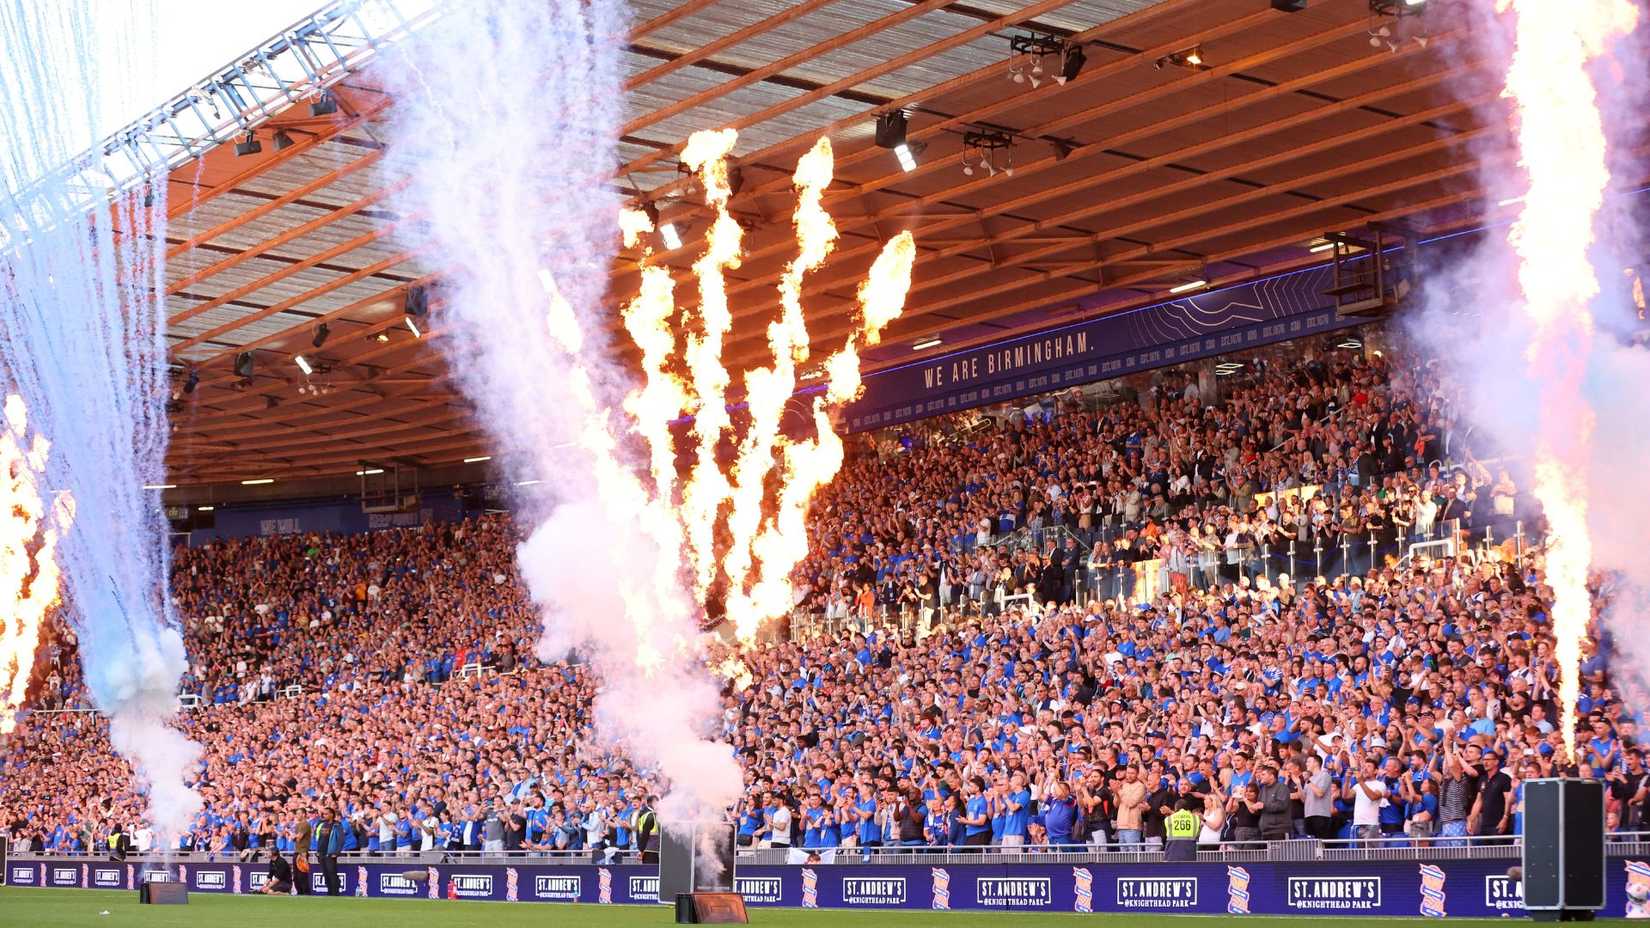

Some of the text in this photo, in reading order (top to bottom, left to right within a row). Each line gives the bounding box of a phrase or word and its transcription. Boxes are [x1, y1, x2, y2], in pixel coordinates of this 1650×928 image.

[924, 366, 943, 389] WE
[952, 358, 978, 383] ARE
[988, 332, 1094, 374] BIRMINGHAM.
[1174, 819, 1191, 831] 266
[1352, 900, 1372, 909] PARK
